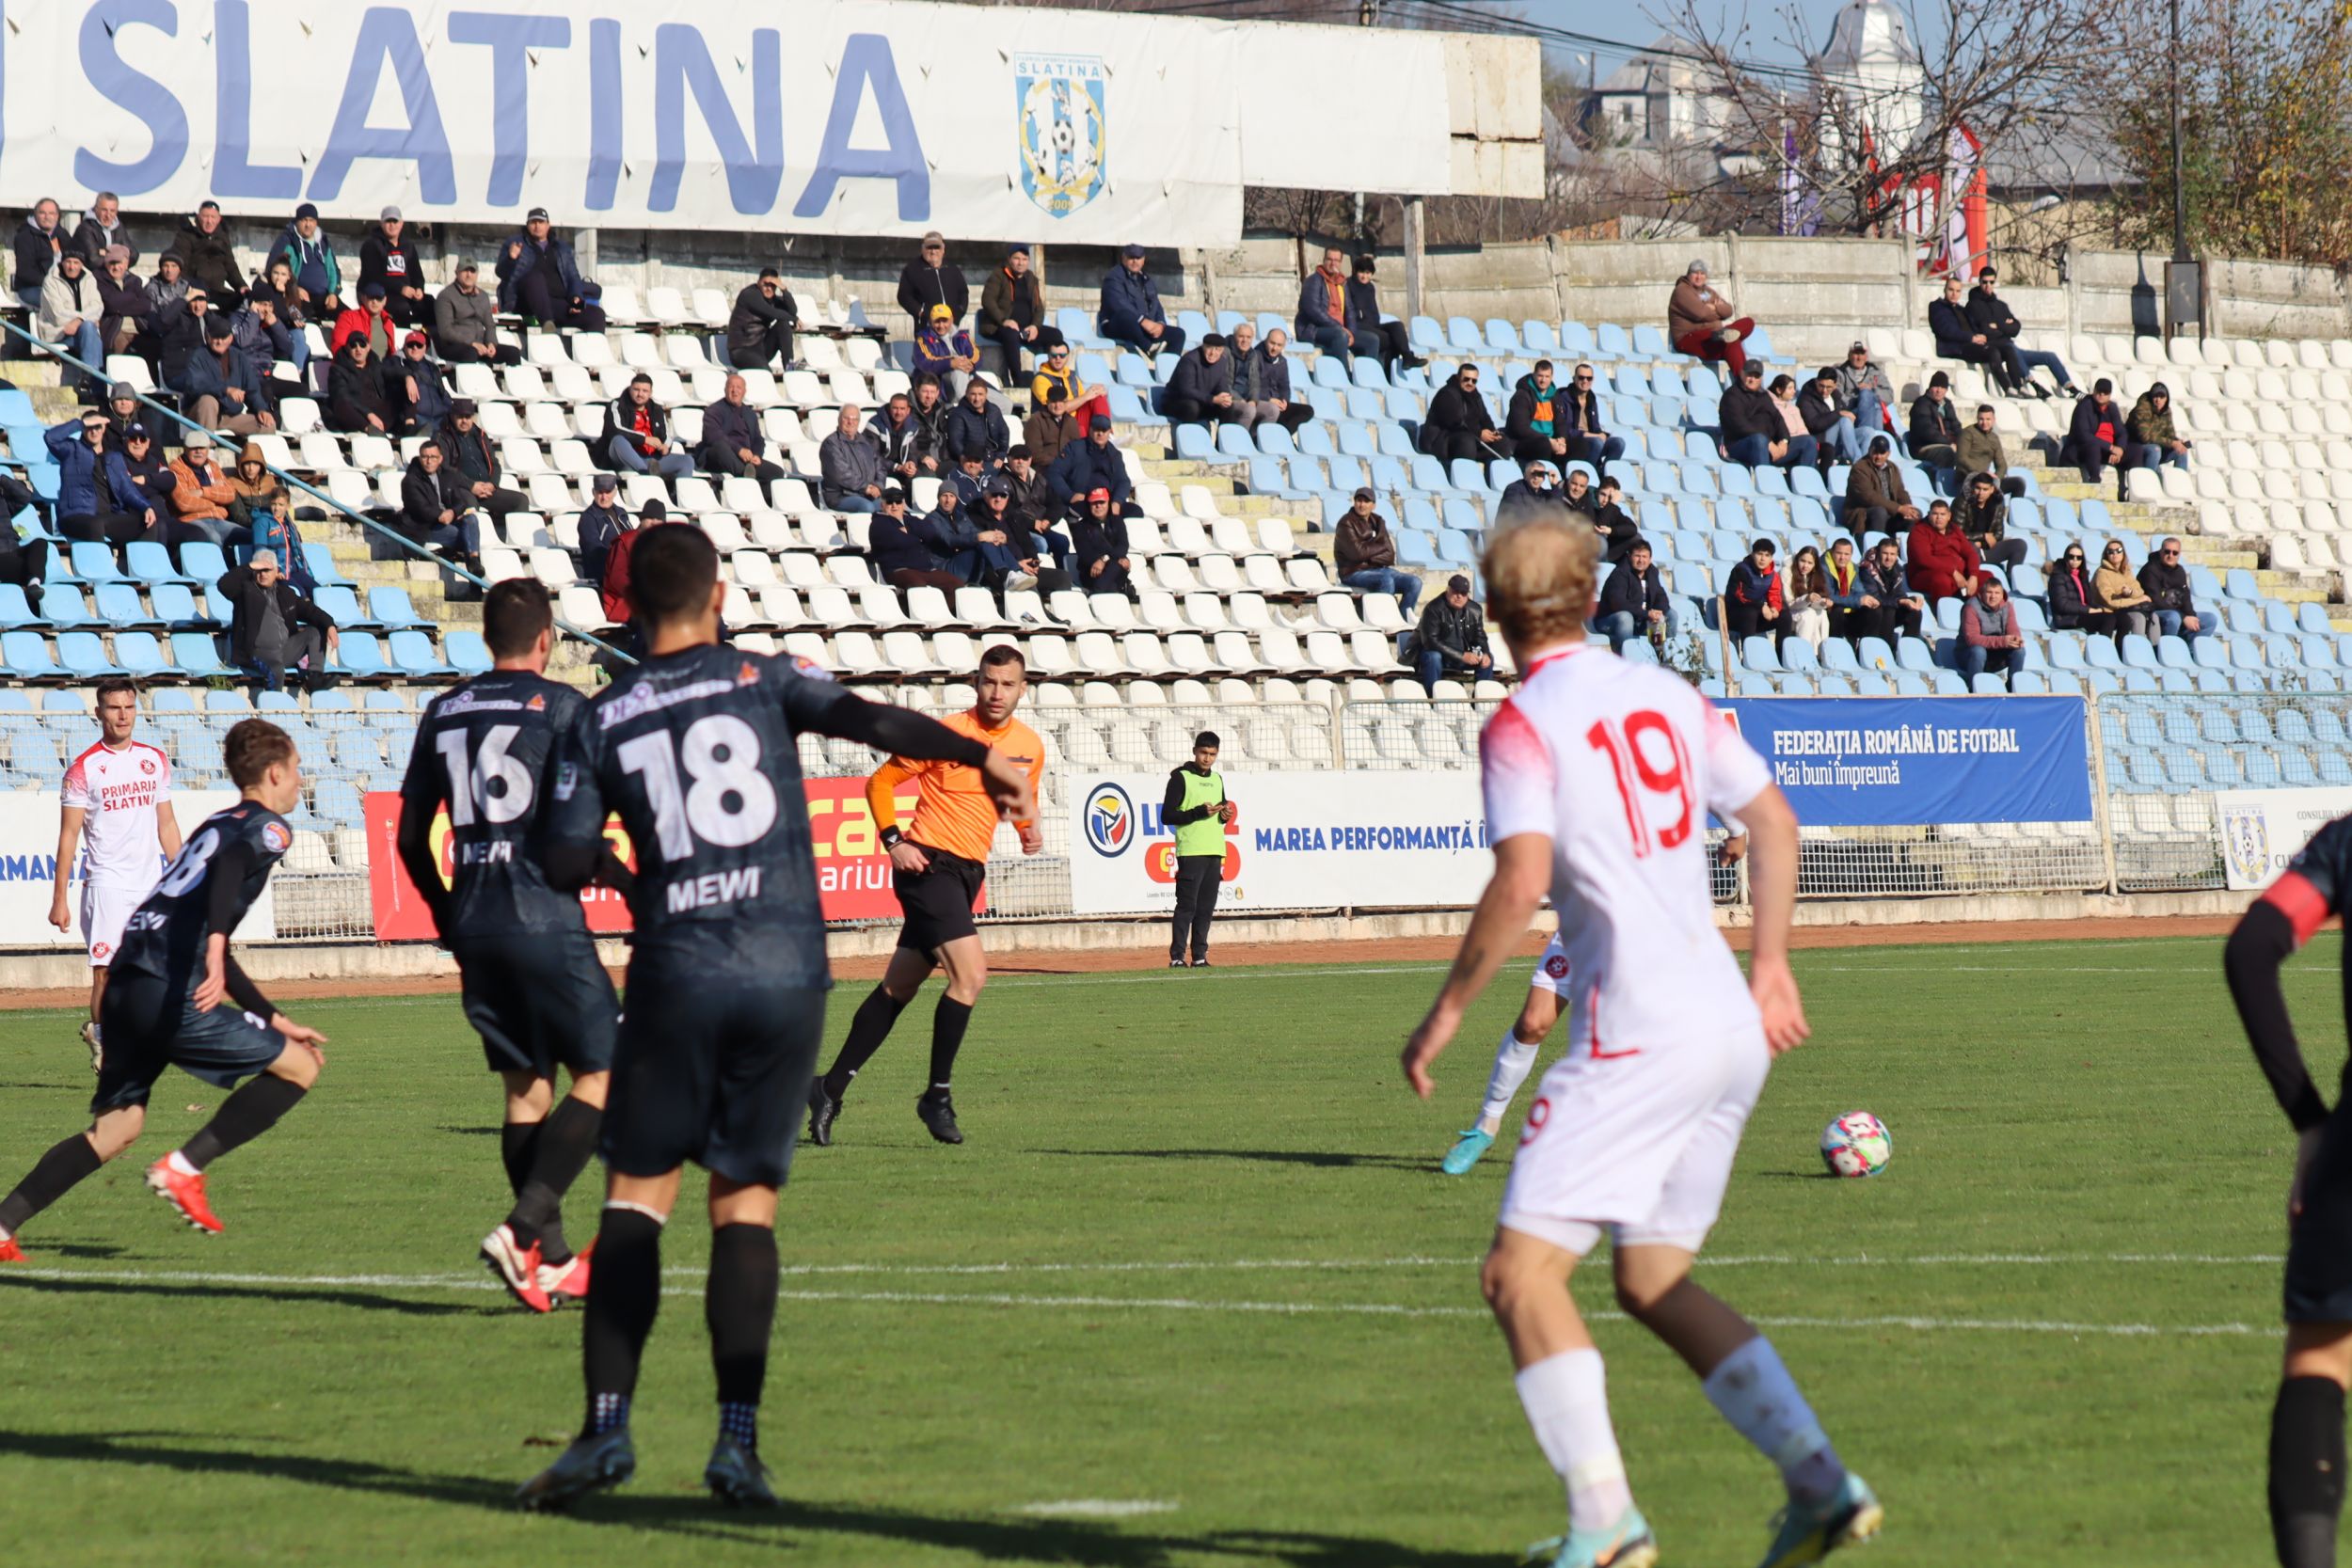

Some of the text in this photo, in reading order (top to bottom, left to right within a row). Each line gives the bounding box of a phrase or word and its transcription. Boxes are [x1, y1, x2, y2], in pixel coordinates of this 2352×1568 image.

[1019, 62, 1100, 77] SLATINA
[74, 0, 930, 222] SLATINA
[1773, 723, 2020, 760] FEDERAȚIA ROMÂNĂ DE FOTBAL
[436, 724, 533, 827] 16
[617, 714, 777, 862] 18
[1586, 709, 1696, 859] 19
[1774, 760, 1900, 791] Mai buni împreună
[1255, 828, 1327, 851] MAREA
[1330, 819, 1474, 855] PERFORMANȚĂ
[667, 865, 759, 914] MEWI
